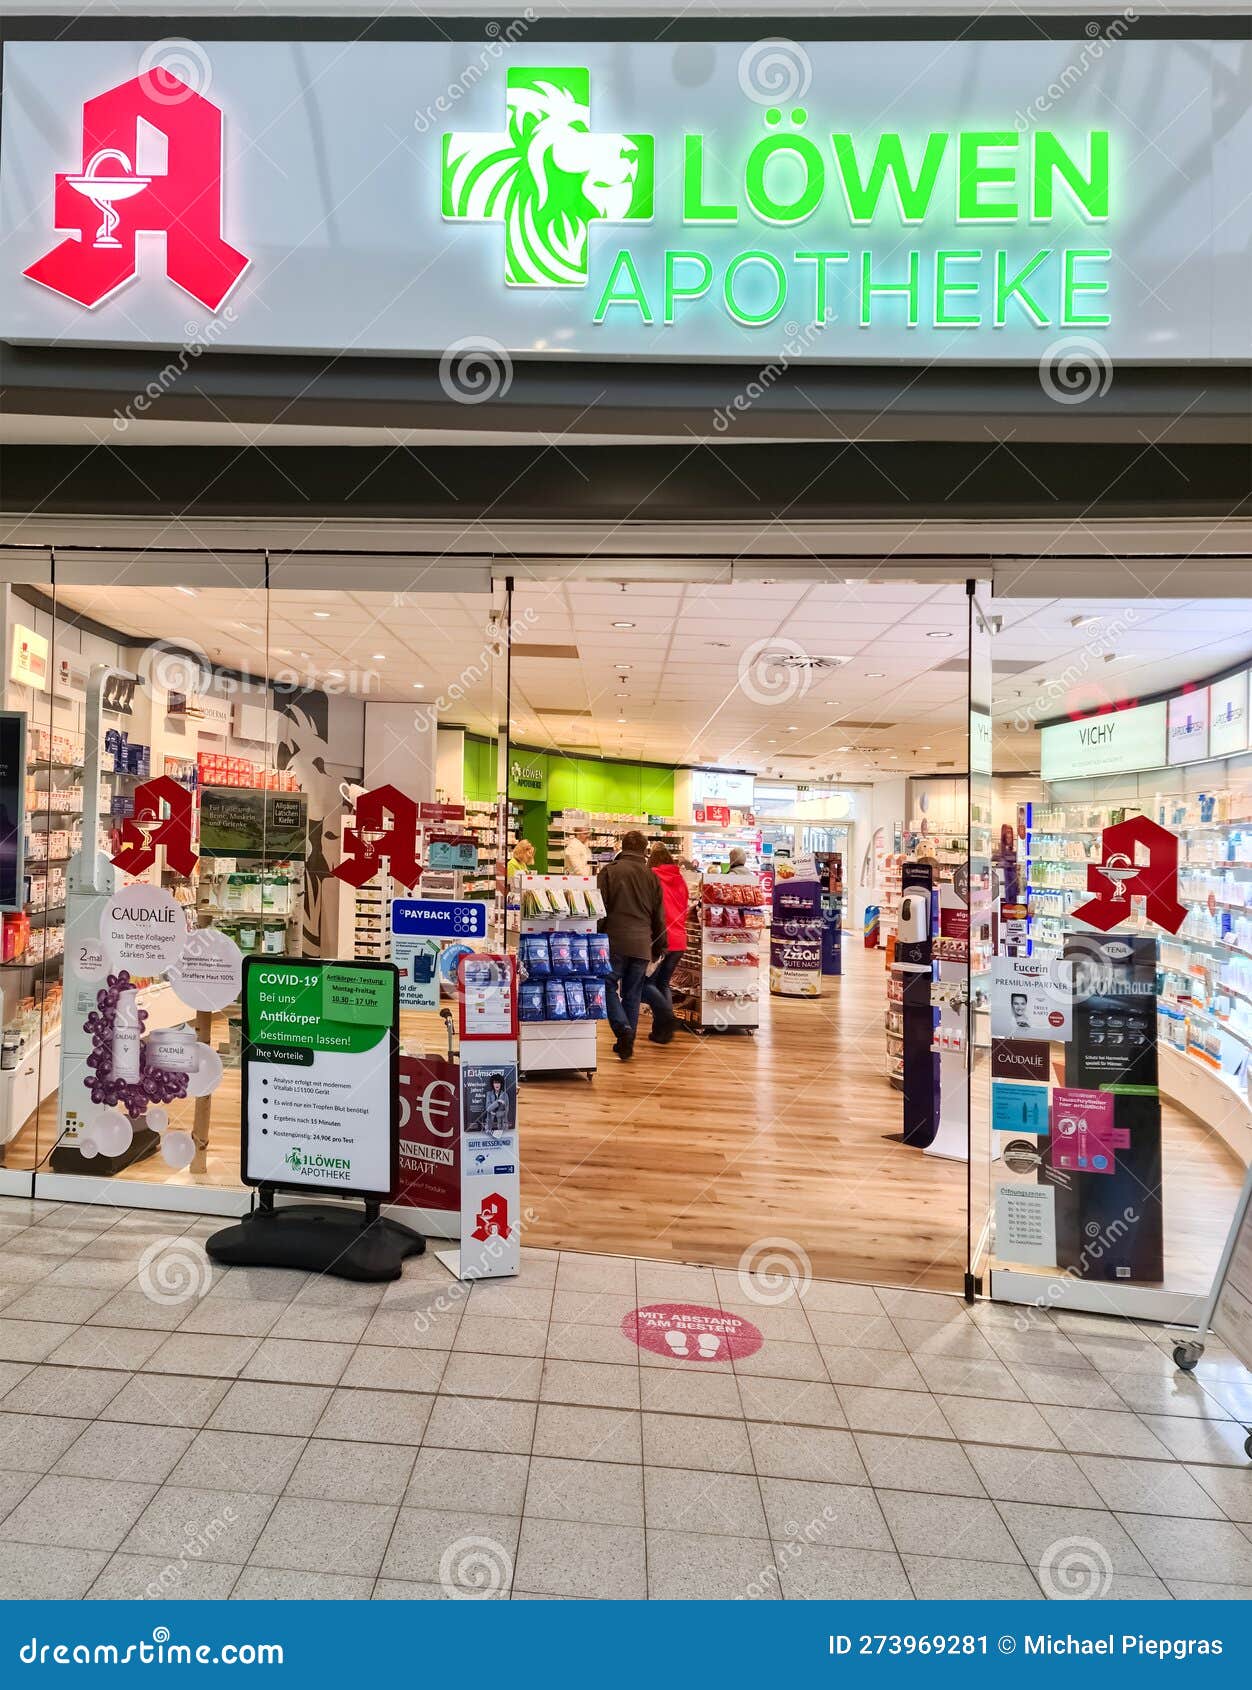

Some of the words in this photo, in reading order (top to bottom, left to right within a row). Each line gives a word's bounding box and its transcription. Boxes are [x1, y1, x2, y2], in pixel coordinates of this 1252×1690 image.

[683, 106, 1110, 224] LÖWEN
[592, 248, 1112, 328] APOTHEKE
[1080, 722, 1115, 746] VICHY
[146, 934, 176, 942] Kollagen?
[80, 948, 102, 962] 2-mal
[1014, 962, 1048, 973] Eucerin
[259, 974, 318, 987] COVID-19
[996, 978, 1068, 990] PREMIUM-PARTNER
[260, 992, 275, 1002] Bei
[278, 994, 296, 1003] uns
[365, 998, 378, 1006] Uhr
[260, 1010, 320, 1025] Antikörper
[260, 1030, 313, 1043] bestimmen
[317, 1034, 351, 1046] lassen!
[256, 1049, 272, 1058] Ihre
[274, 1050, 304, 1060] Vorteile
[347, 1106, 369, 1114] benötigt
[274, 1115, 296, 1123] Ergebnis
[309, 1154, 350, 1169] LÖWEN
[300, 1167, 351, 1180] APOTHEKE
[671, 1315, 742, 1327] ABSTAND
[676, 1322, 736, 1333] BESTEN
